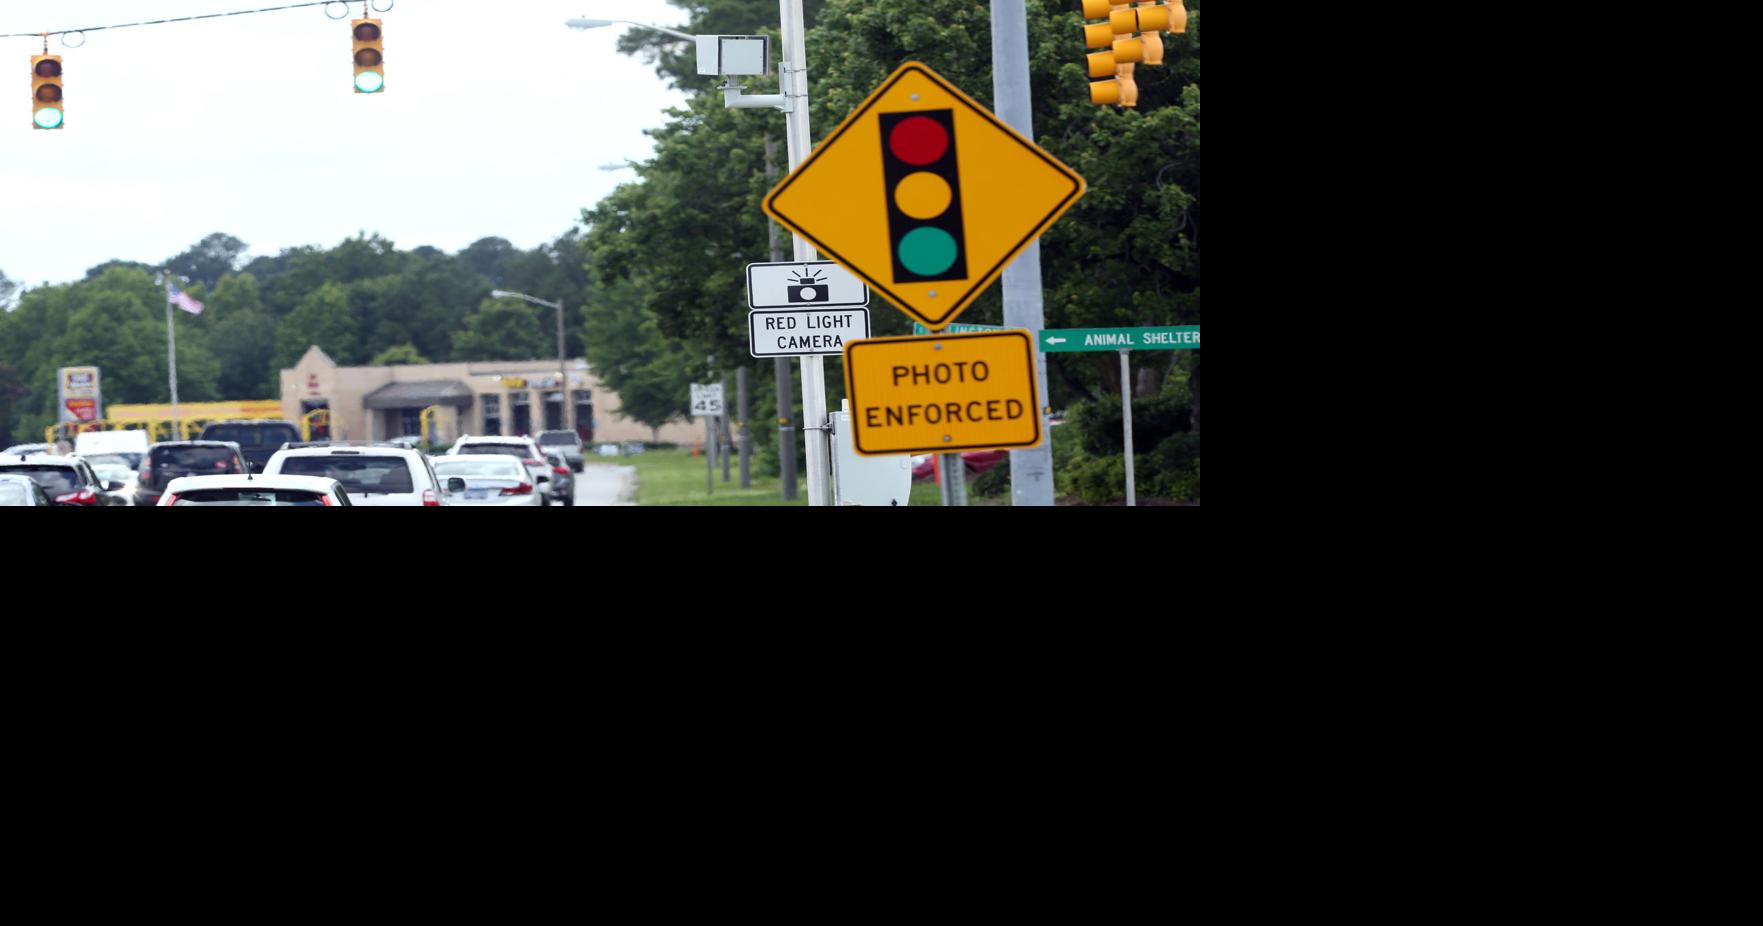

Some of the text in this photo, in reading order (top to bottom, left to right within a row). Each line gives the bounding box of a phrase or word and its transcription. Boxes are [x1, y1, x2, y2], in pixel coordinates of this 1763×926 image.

[765, 315, 853, 330] RED LIGHT
[777, 335, 843, 349] CAMERA
[1084, 331, 1200, 346] ANIMAL SHELTER
[892, 361, 989, 387] PHOTO
[695, 399, 721, 412] 45
[865, 399, 1023, 428] ENFORCED
